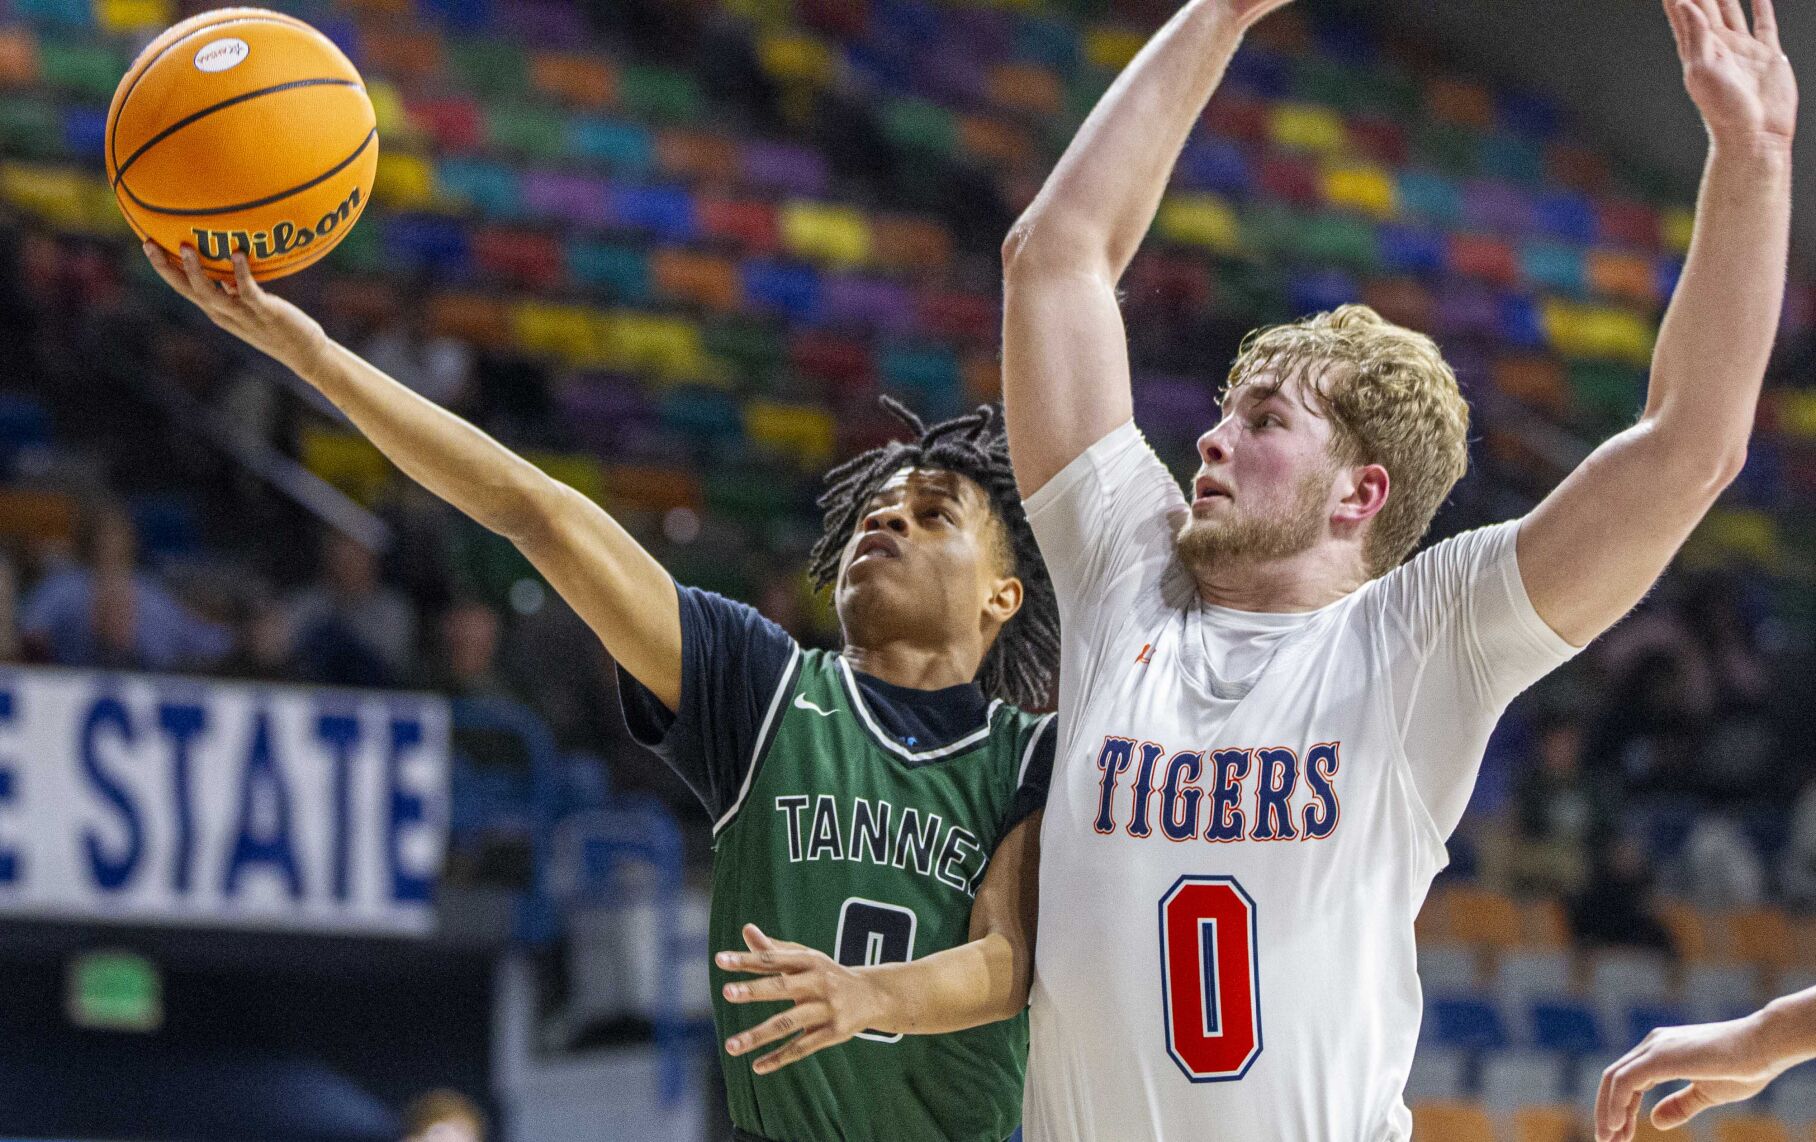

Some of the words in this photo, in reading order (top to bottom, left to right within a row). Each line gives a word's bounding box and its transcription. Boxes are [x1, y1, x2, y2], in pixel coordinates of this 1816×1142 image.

[191, 186, 360, 261] Wilson
[78, 696, 438, 903] STATE
[1094, 735, 1341, 843] TIGERS
[1158, 874, 1264, 1084] 0
